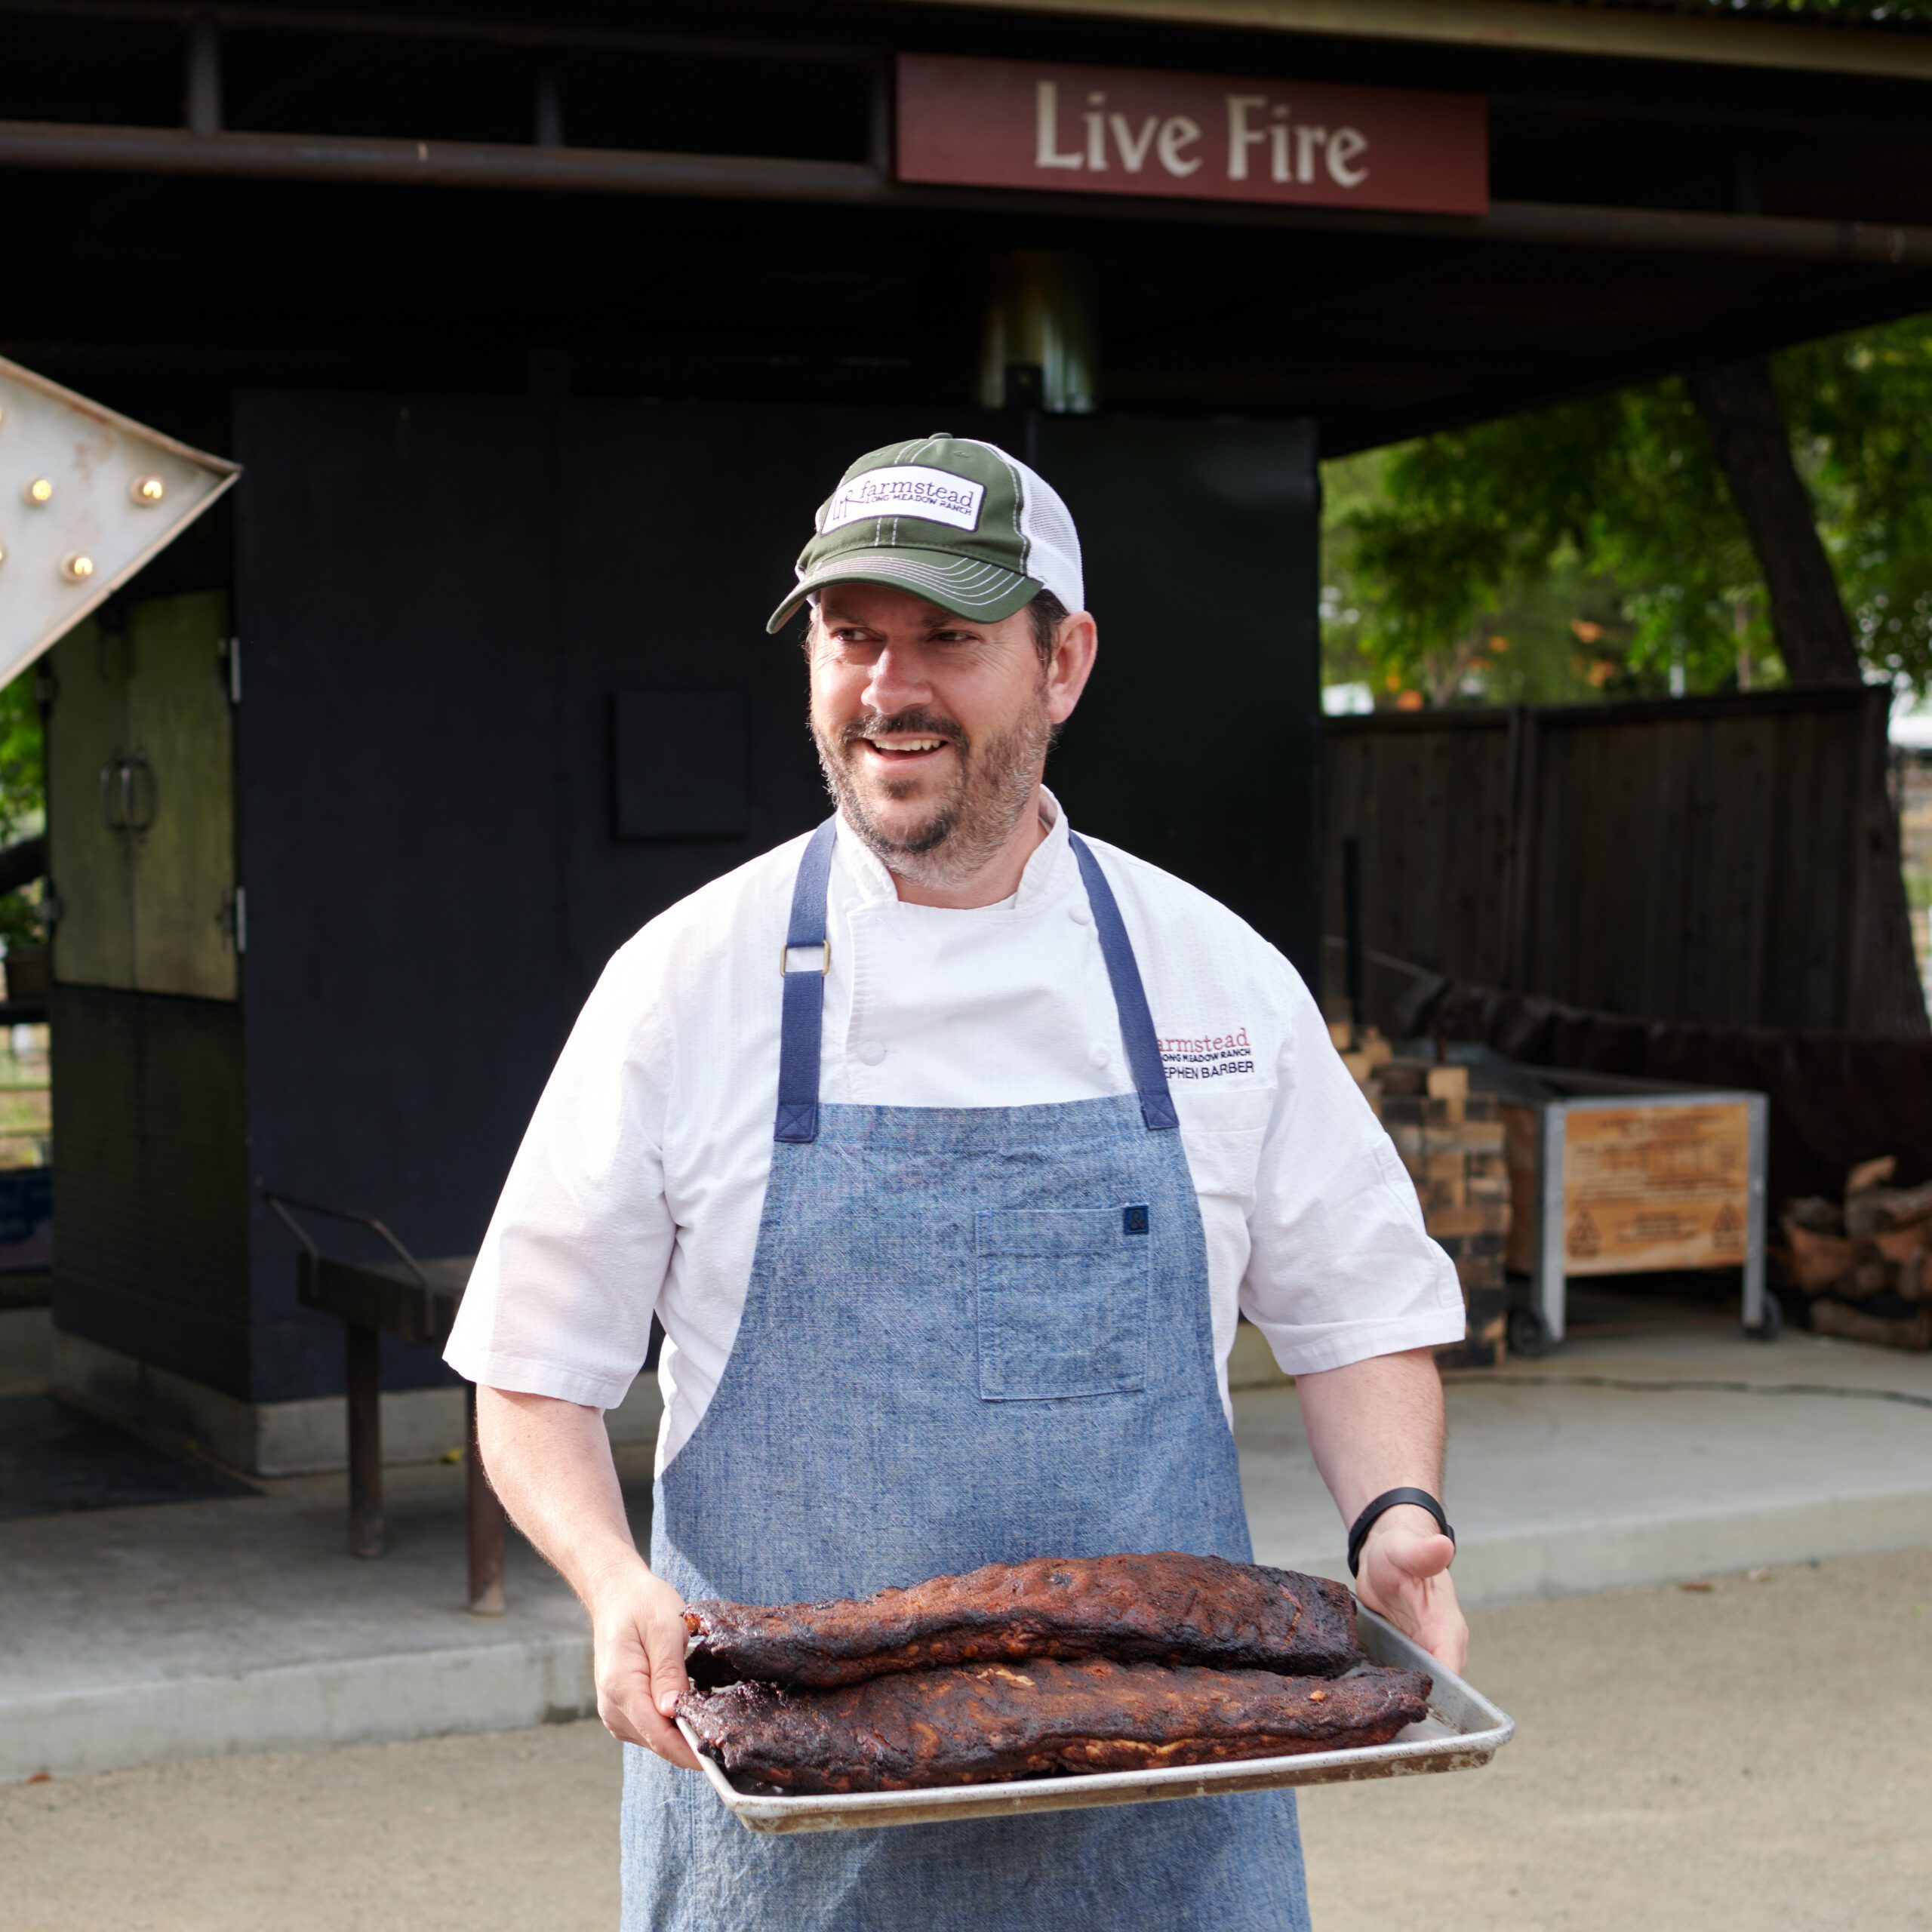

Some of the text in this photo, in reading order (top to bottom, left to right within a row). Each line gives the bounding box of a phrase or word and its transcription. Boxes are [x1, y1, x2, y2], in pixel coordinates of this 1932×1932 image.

[1035, 80, 1370, 188] Live Fire
[859, 480, 974, 509] farmstead
[865, 494, 972, 515] LONG MEADOW RANCH
[1156, 1026, 1251, 1054] armstead
[1162, 1048, 1251, 1063] ONG MEADOW RANCH
[1163, 1060, 1254, 1079] EPHEN BARBER
